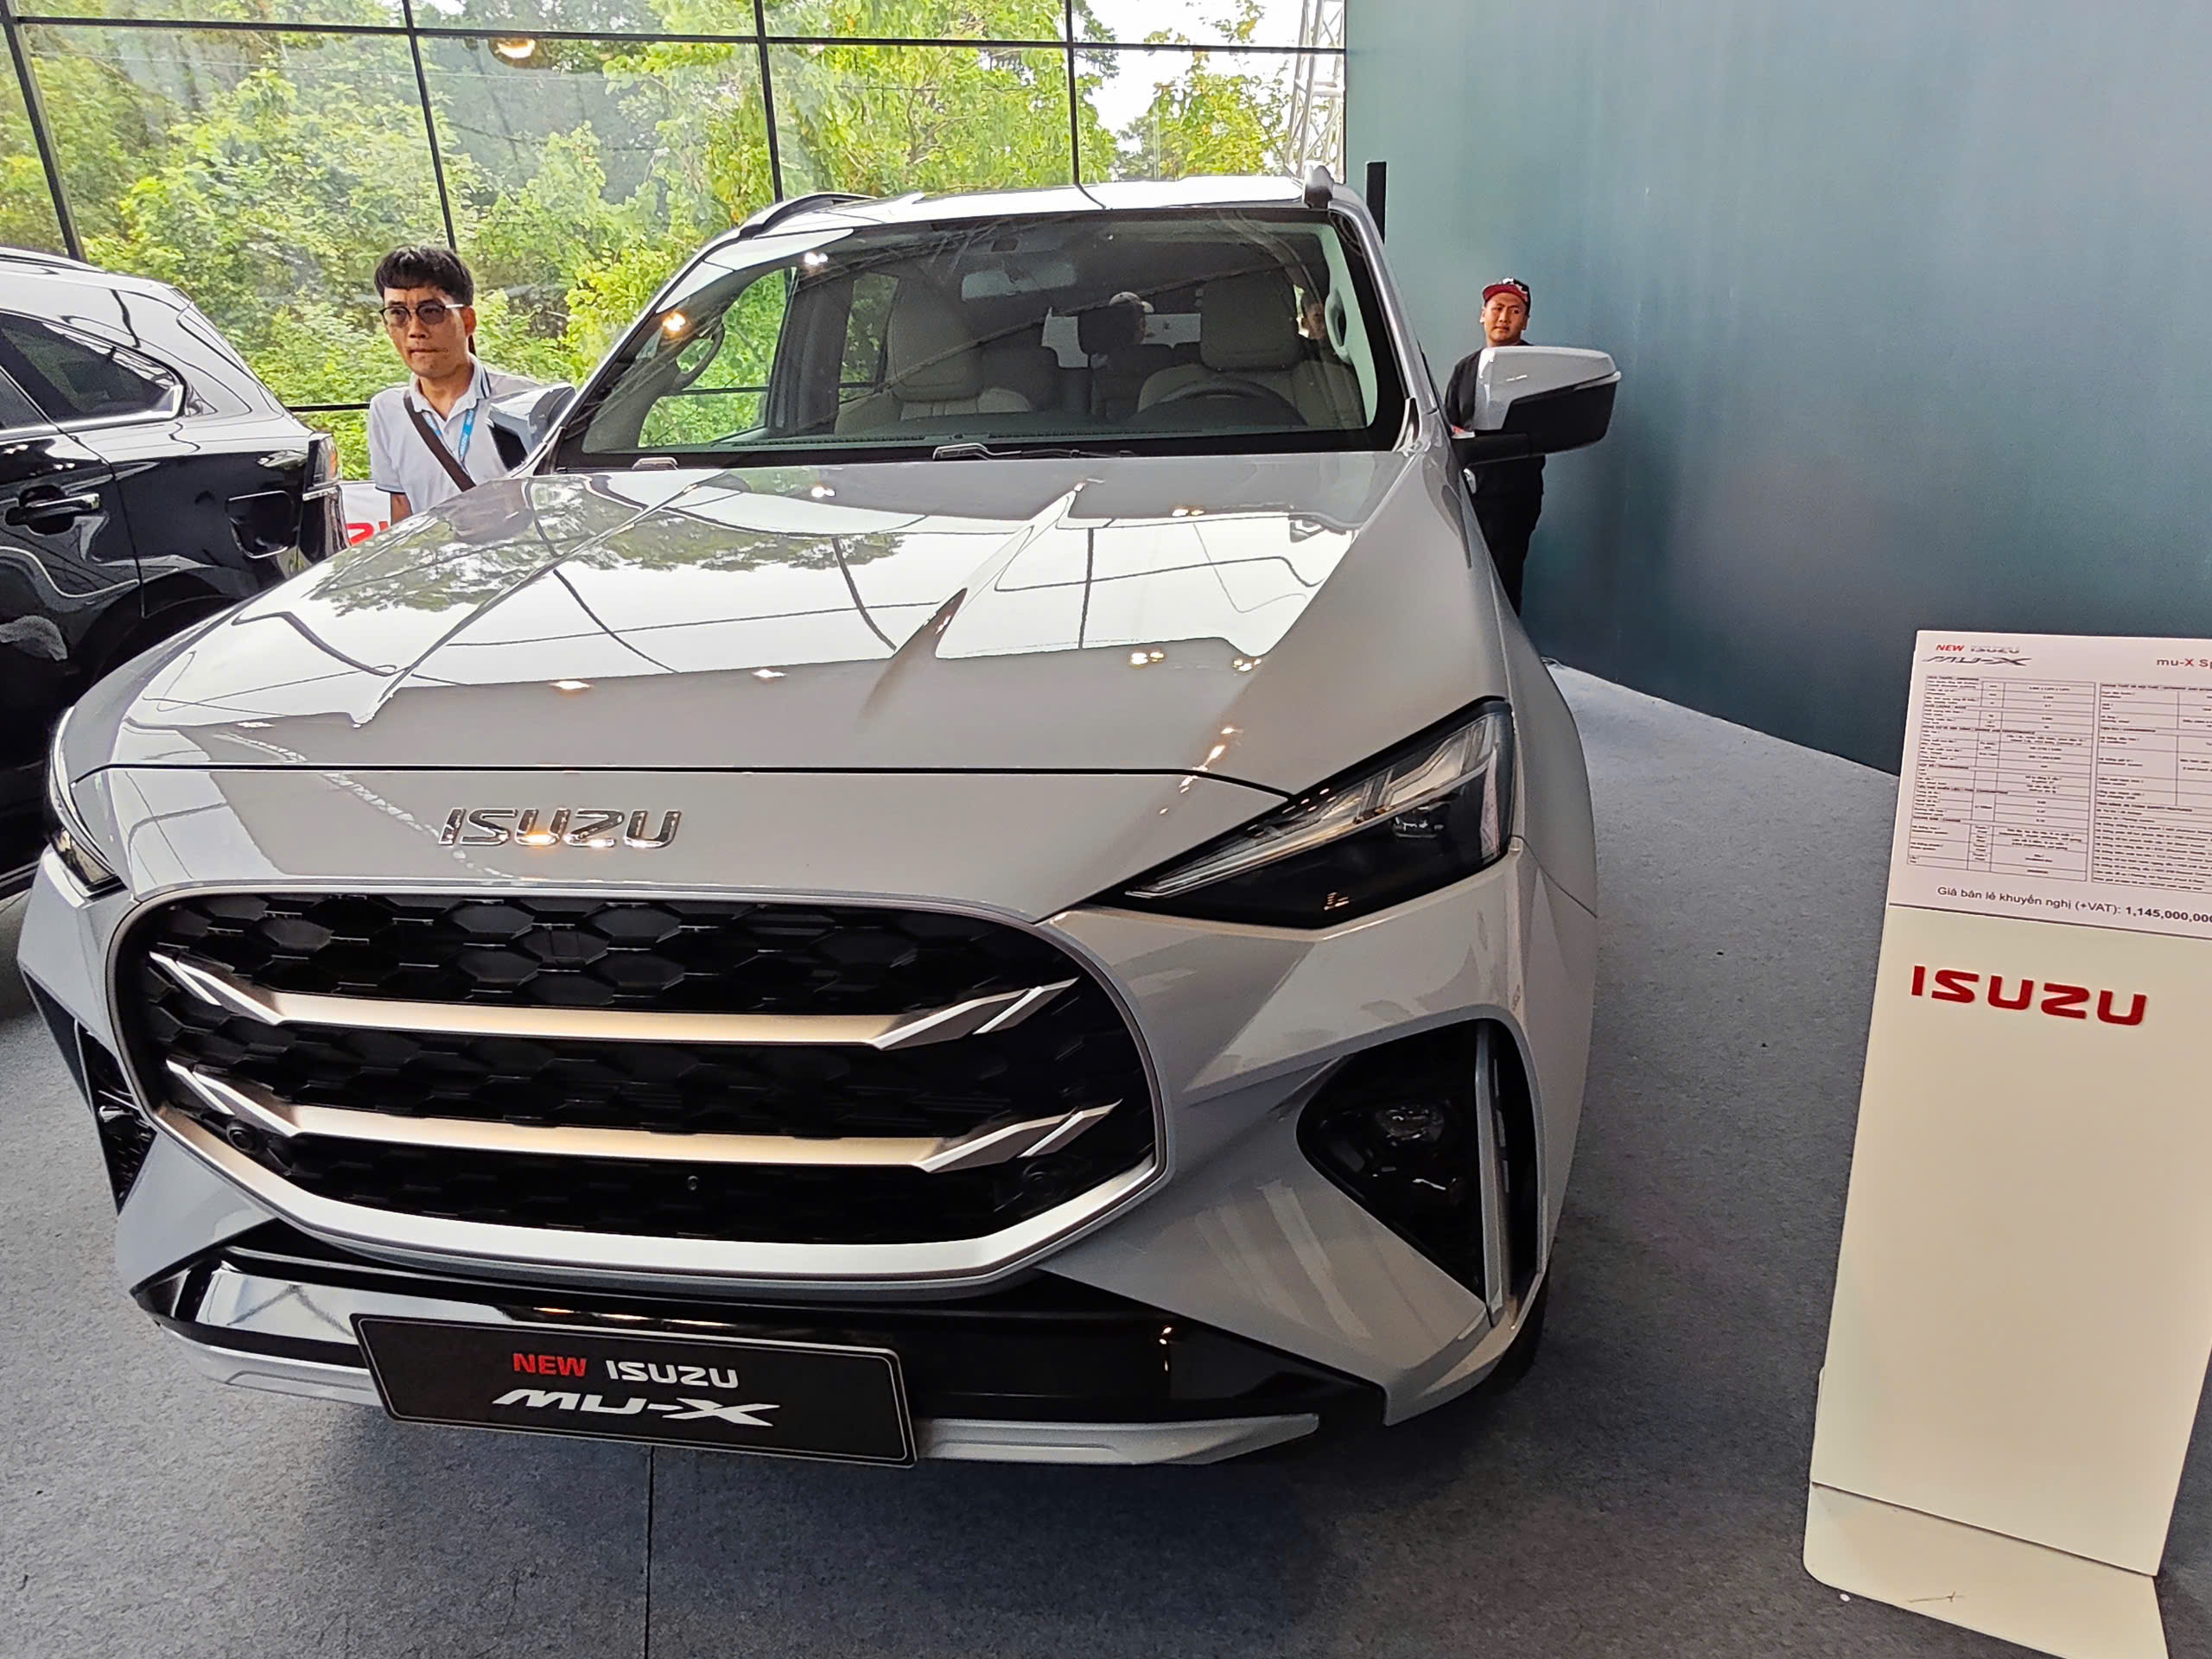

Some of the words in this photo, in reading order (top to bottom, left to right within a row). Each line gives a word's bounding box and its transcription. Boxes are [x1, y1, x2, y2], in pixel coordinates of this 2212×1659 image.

[438, 807, 682, 849] ISUZU
[1937, 887, 1957, 896] Giá
[1961, 889, 1982, 899] bán
[2045, 899, 2071, 910] nghị
[2075, 900, 2121, 915] (+VAT):
[1911, 964, 2147, 1026] ISUZU
[513, 1353, 587, 1376] NEW
[606, 1360, 739, 1389] ISUZU
